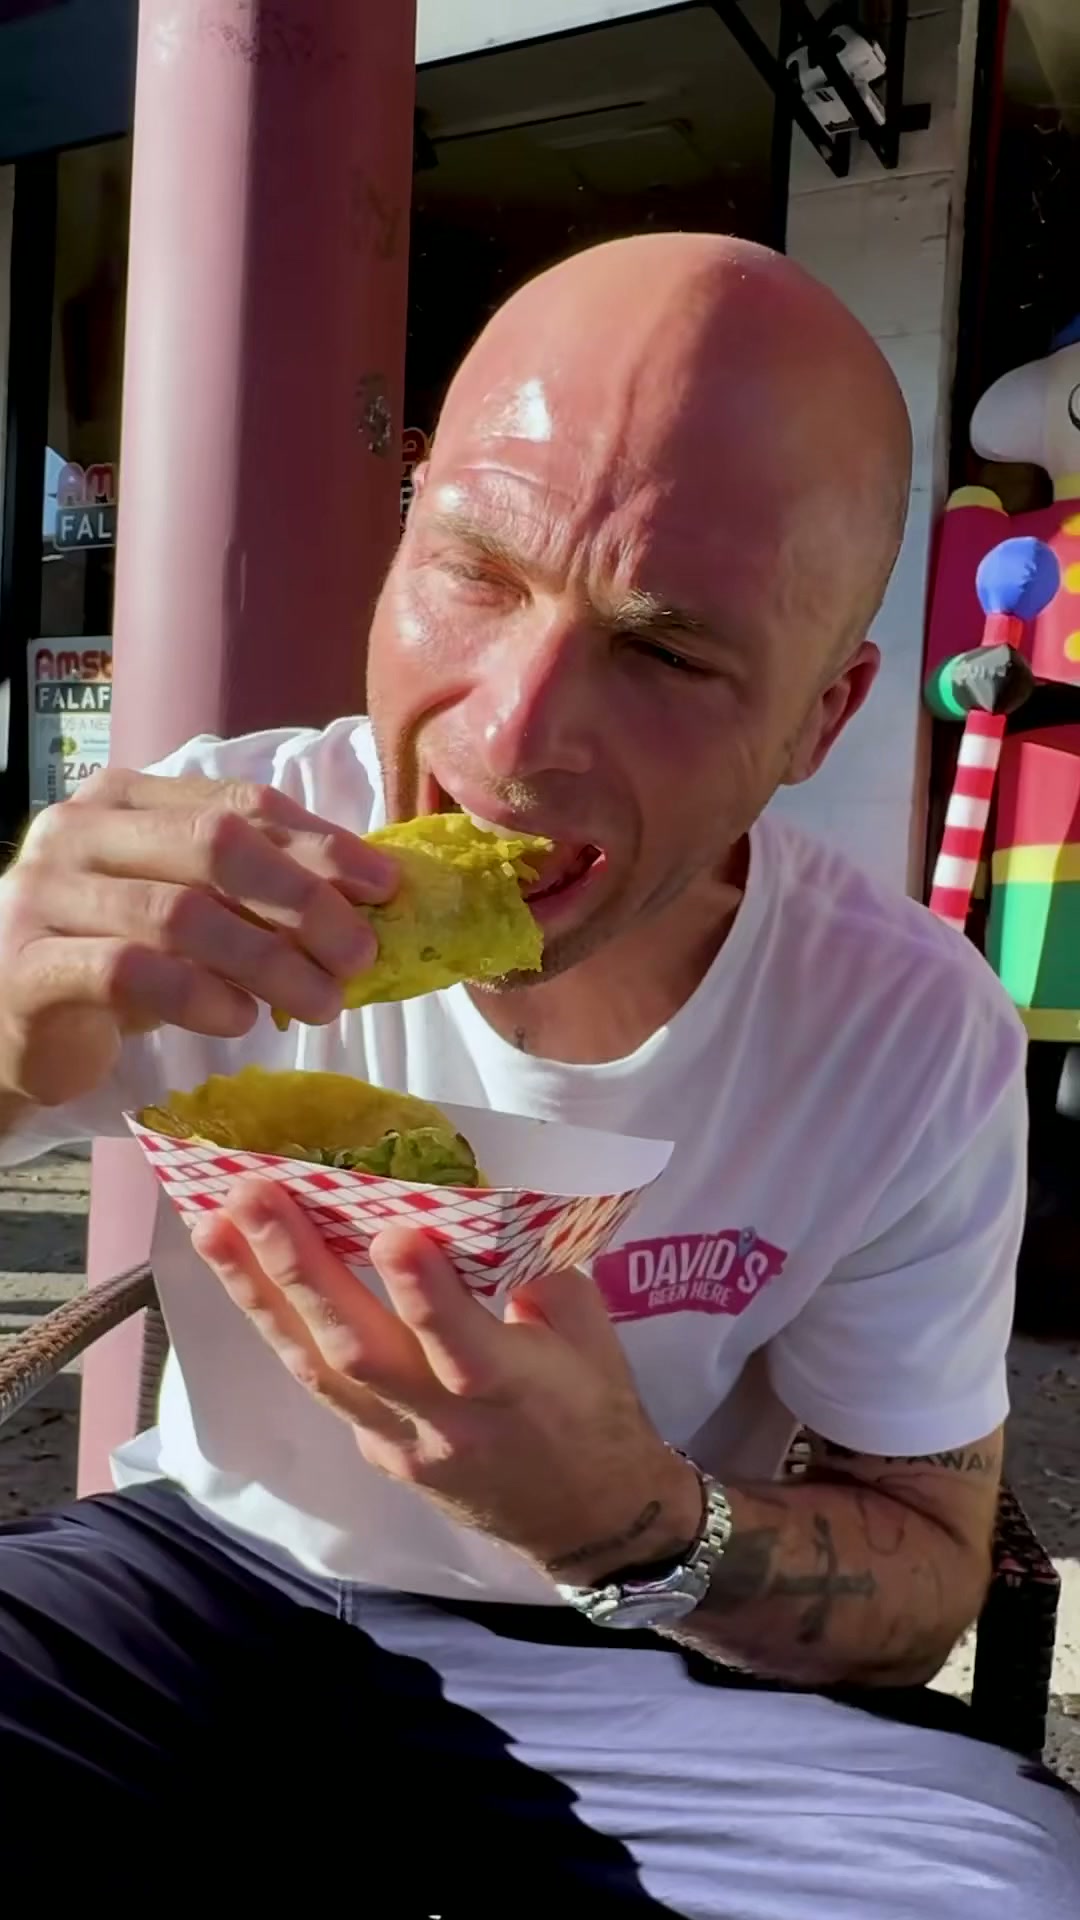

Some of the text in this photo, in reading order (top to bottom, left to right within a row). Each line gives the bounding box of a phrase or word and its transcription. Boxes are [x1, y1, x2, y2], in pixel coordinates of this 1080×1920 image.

[61, 512, 112, 541] FAL
[39, 686, 111, 710] FALAF
[648, 1280, 733, 1308] BEEN HERE
